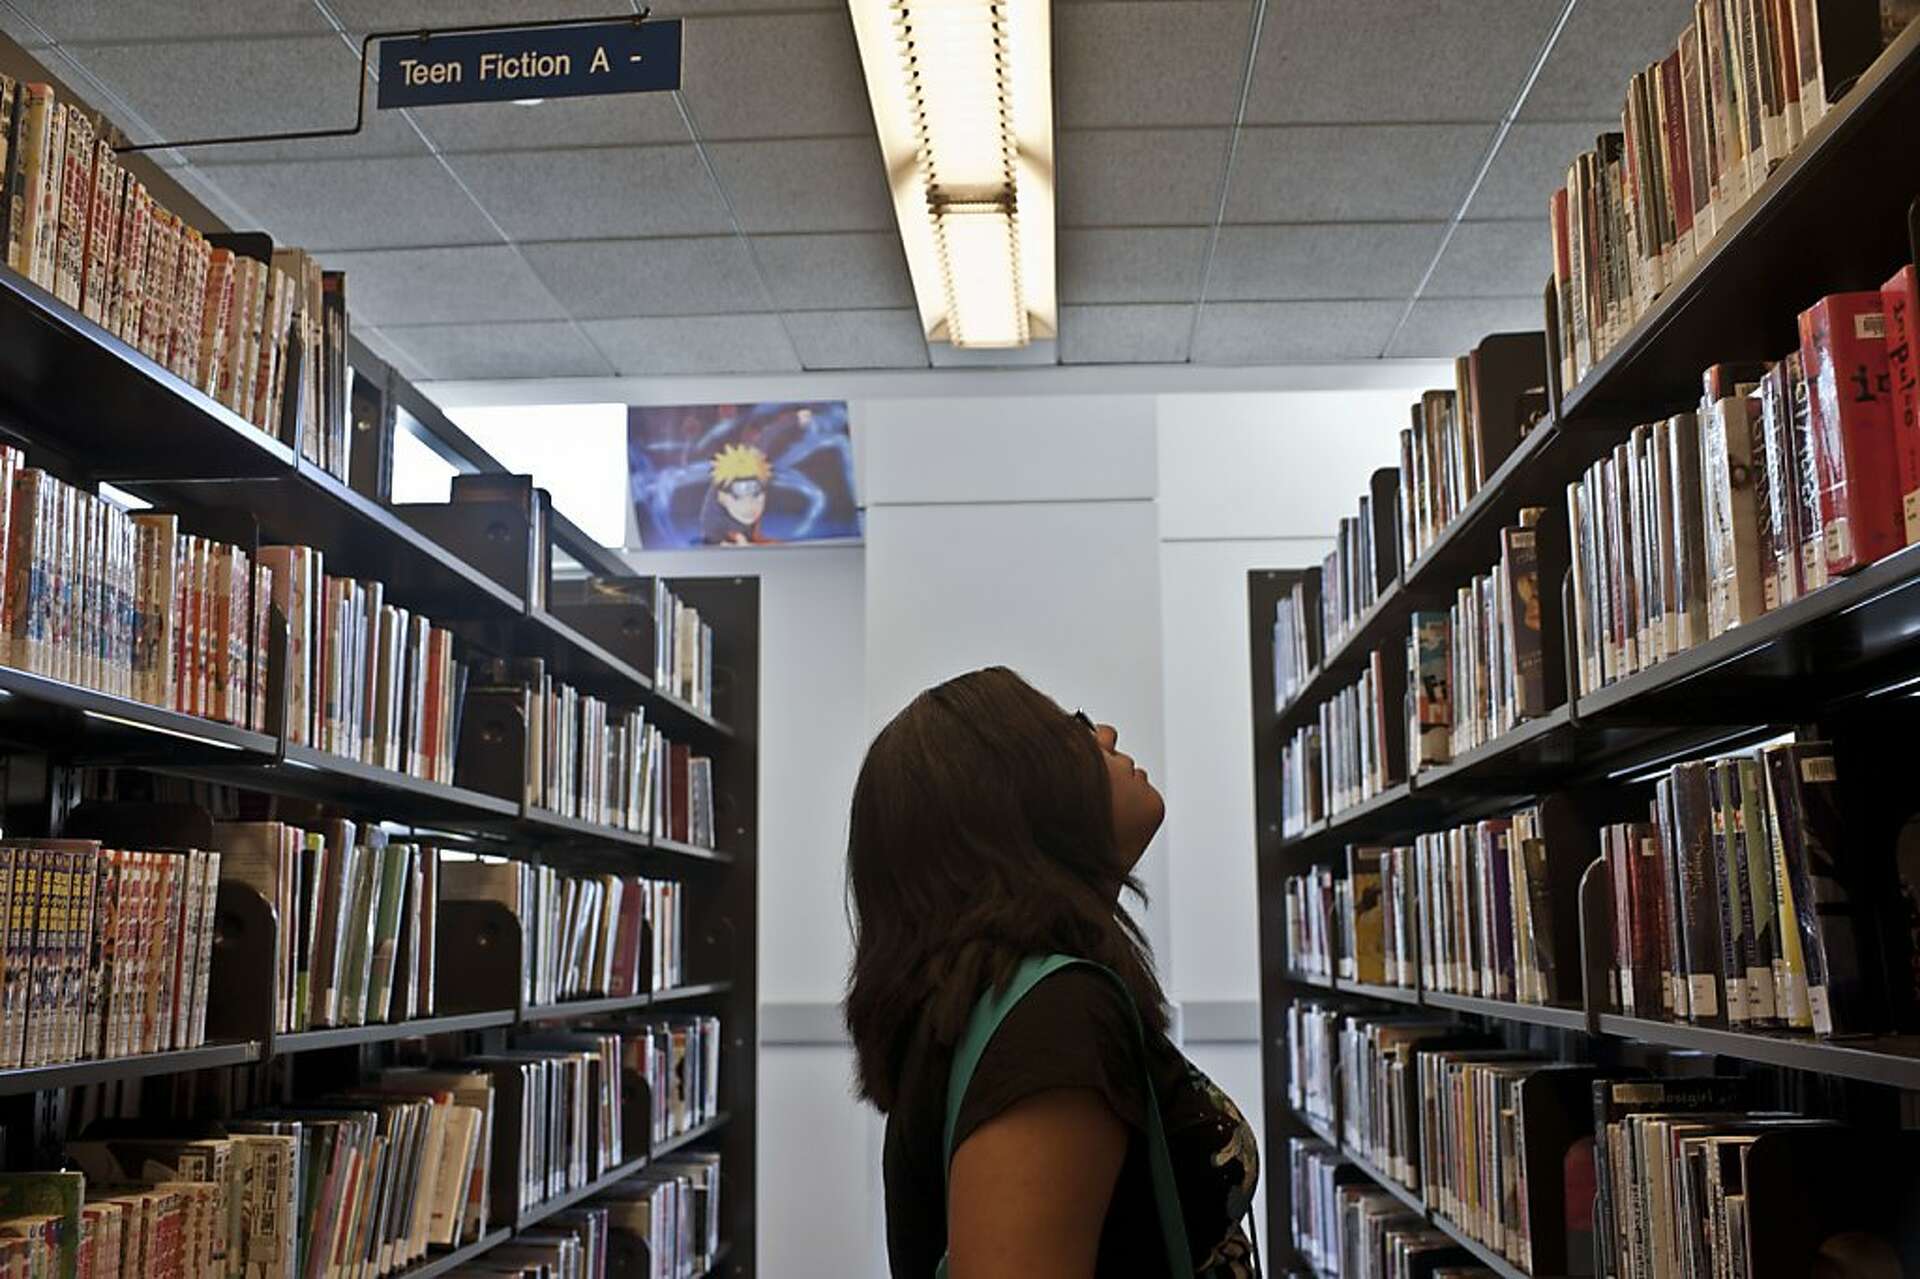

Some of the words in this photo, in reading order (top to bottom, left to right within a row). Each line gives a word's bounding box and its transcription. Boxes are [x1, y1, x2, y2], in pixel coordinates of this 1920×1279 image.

[400, 59, 462, 86] Teen
[479, 51, 571, 81] Fiction
[589, 46, 611, 74] A
